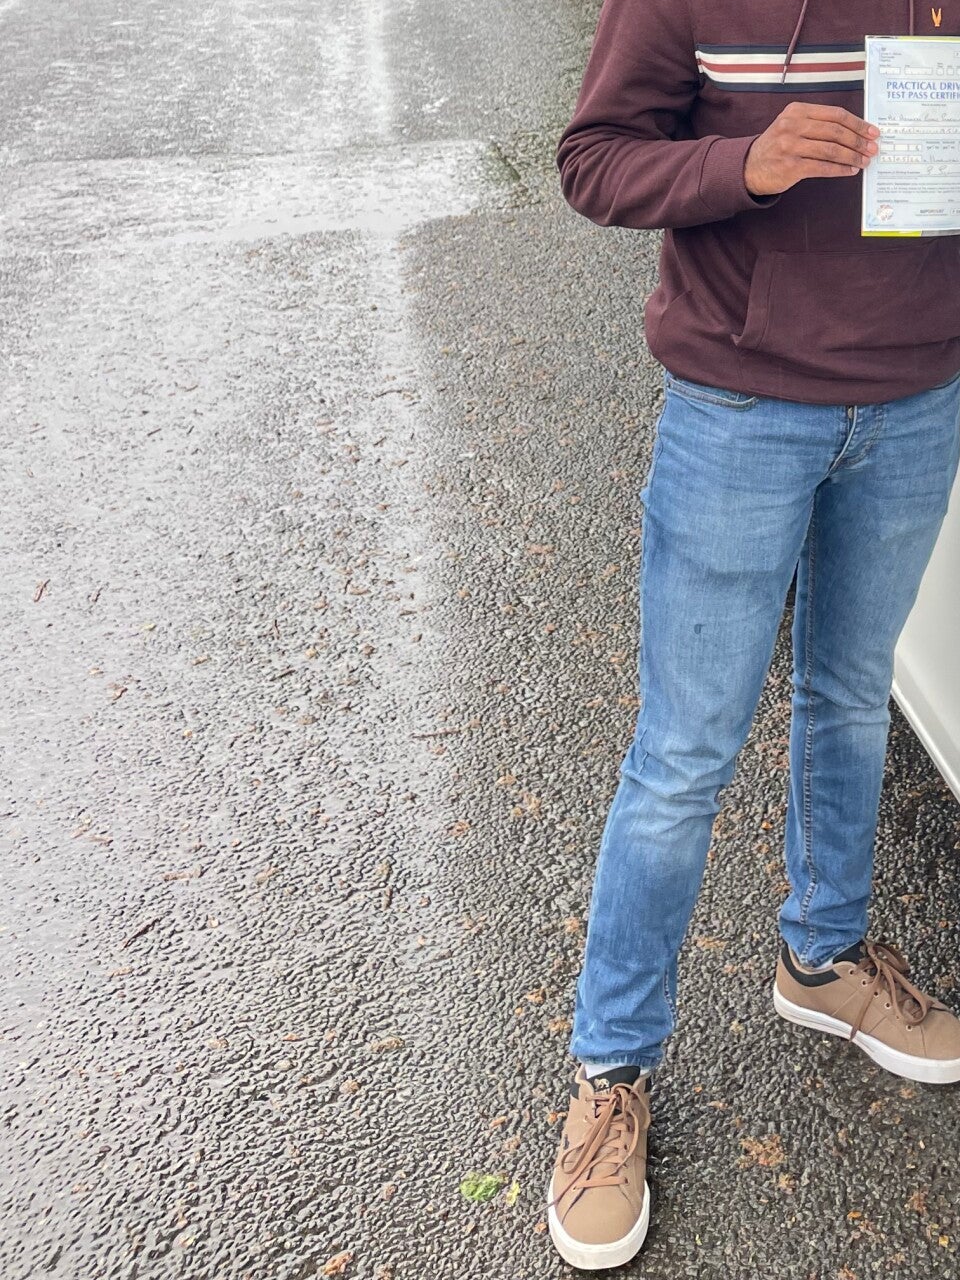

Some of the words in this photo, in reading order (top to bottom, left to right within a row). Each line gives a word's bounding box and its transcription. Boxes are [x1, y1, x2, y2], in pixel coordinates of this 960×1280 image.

[886, 81, 936, 90] PRACTICAL
[887, 91, 905, 99] TEST
[908, 91, 928, 99] PASS
